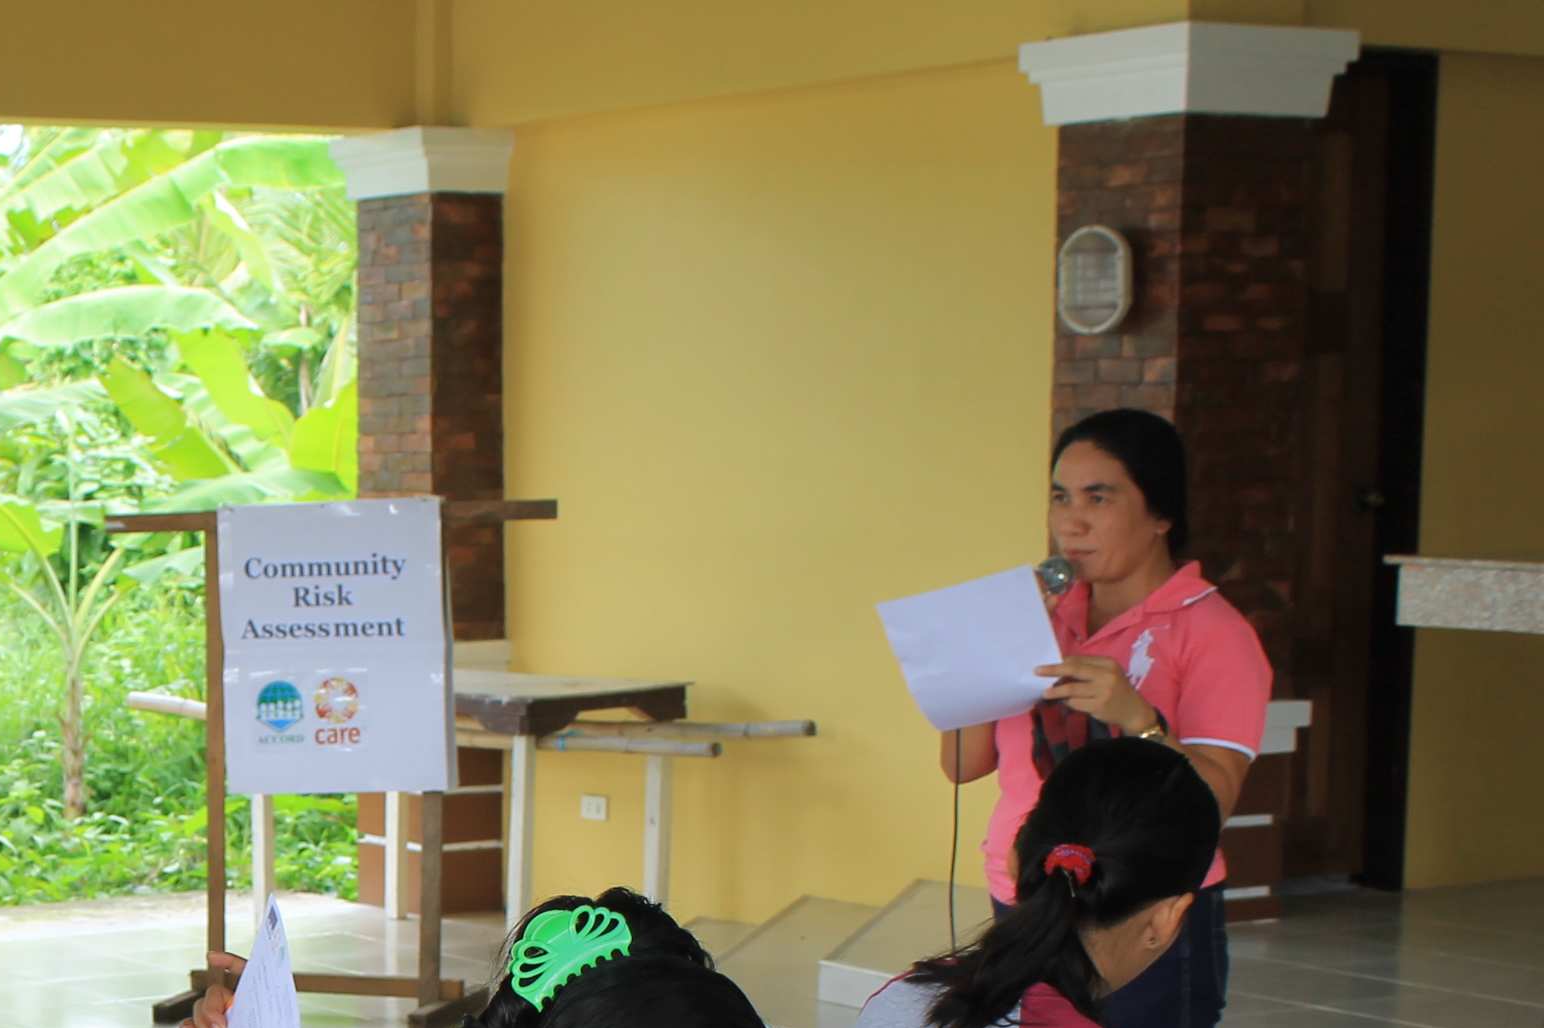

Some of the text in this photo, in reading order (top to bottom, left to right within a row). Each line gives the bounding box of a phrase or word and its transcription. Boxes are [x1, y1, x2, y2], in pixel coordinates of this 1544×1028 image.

[244, 552, 406, 580] Community
[293, 584, 353, 608] Risk
[241, 617, 405, 639] Assessment
[314, 726, 361, 745] care
